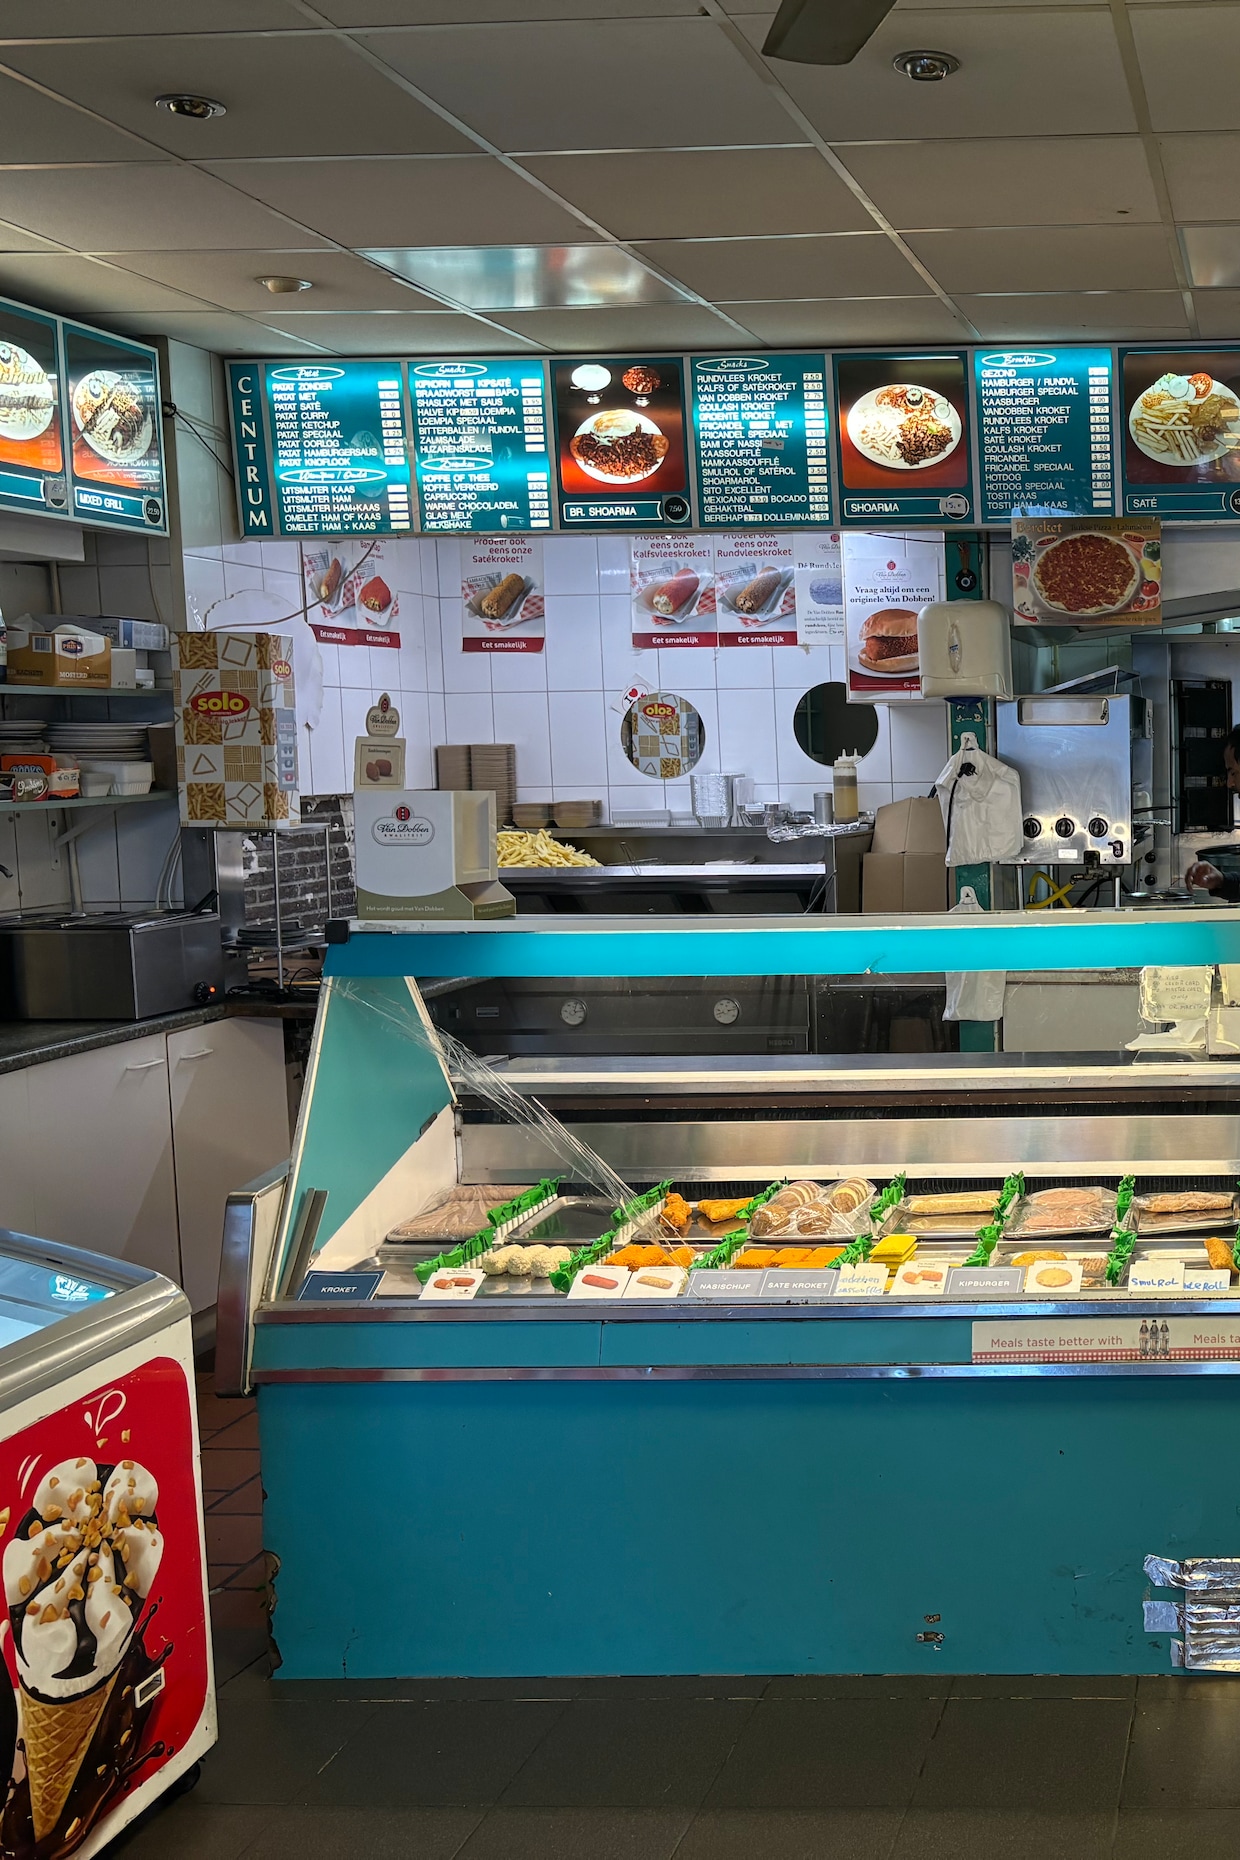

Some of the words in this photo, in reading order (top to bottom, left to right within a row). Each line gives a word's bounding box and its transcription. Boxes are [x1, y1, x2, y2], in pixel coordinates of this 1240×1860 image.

[718, 361, 747, 370] Snacks
[697, 375, 745, 383] RUNDVLEES
[748, 373, 782, 382] KROKET
[743, 382, 796, 391] SATÉKROKET
[982, 388, 1034, 396] HAMBURGER
[698, 394, 714, 402] VAN
[275, 412, 297, 420] PATAT
[301, 411, 329, 420] CURRY
[302, 421, 340, 429] KETCHUP
[303, 430, 343, 438] SPECIAAL
[238, 377, 267, 526] CENTRUM
[304, 448, 377, 456] HAMBURGERSAUS
[701, 448, 761, 457] KAASSOUFFLÉ
[984, 445, 1025, 453] GOULASH
[702, 457, 779, 466] HAMKAASSOUFFLÉ
[702, 468, 740, 476] SMULROL
[759, 466, 795, 475] SATÉROL
[703, 477, 760, 485] SHOARMAROL
[79, 493, 102, 507] MIXED
[104, 497, 124, 510] GRILL
[424, 493, 477, 501] CAPPUCCINO
[704, 496, 746, 504] MEXICANO
[771, 495, 807, 503] BOCADO
[425, 502, 456, 510] WARME
[459, 502, 519, 510] CHOCOLADEM.
[851, 503, 899, 512] SHOARMA
[1133, 498, 1157, 508] SATÉ
[570, 508, 585, 516] BR.
[589, 507, 637, 516] SHOARMA
[704, 505, 754, 513] GEHAKTBAL
[343, 513, 354, 521] OF
[1016, 522, 1062, 533] Bereket
[650, 541, 670, 549] eens
[633, 549, 711, 558] Kalfsvleeskroket!
[717, 548, 792, 557] Rundvleeskroket
[855, 587, 878, 595] Vraag
[880, 586, 899, 595] altijd
[850, 596, 884, 604] originele
[652, 636, 663, 644] Eet
[665, 636, 699, 644] smakelijk
[750, 635, 784, 644] smakelijk
[494, 641, 526, 650] smakelijk
[274, 664, 289, 674] solo
[198, 693, 243, 710] solo
[377, 824, 396, 833] Van
[398, 824, 428, 833] Dobben
[991, 1338, 1022, 1347] Meals
[1027, 1337, 1054, 1347] taste
[1058, 1337, 1095, 1347] better
[1099, 1335, 1122, 1345] with
[1194, 1334, 1227, 1344] Meals
